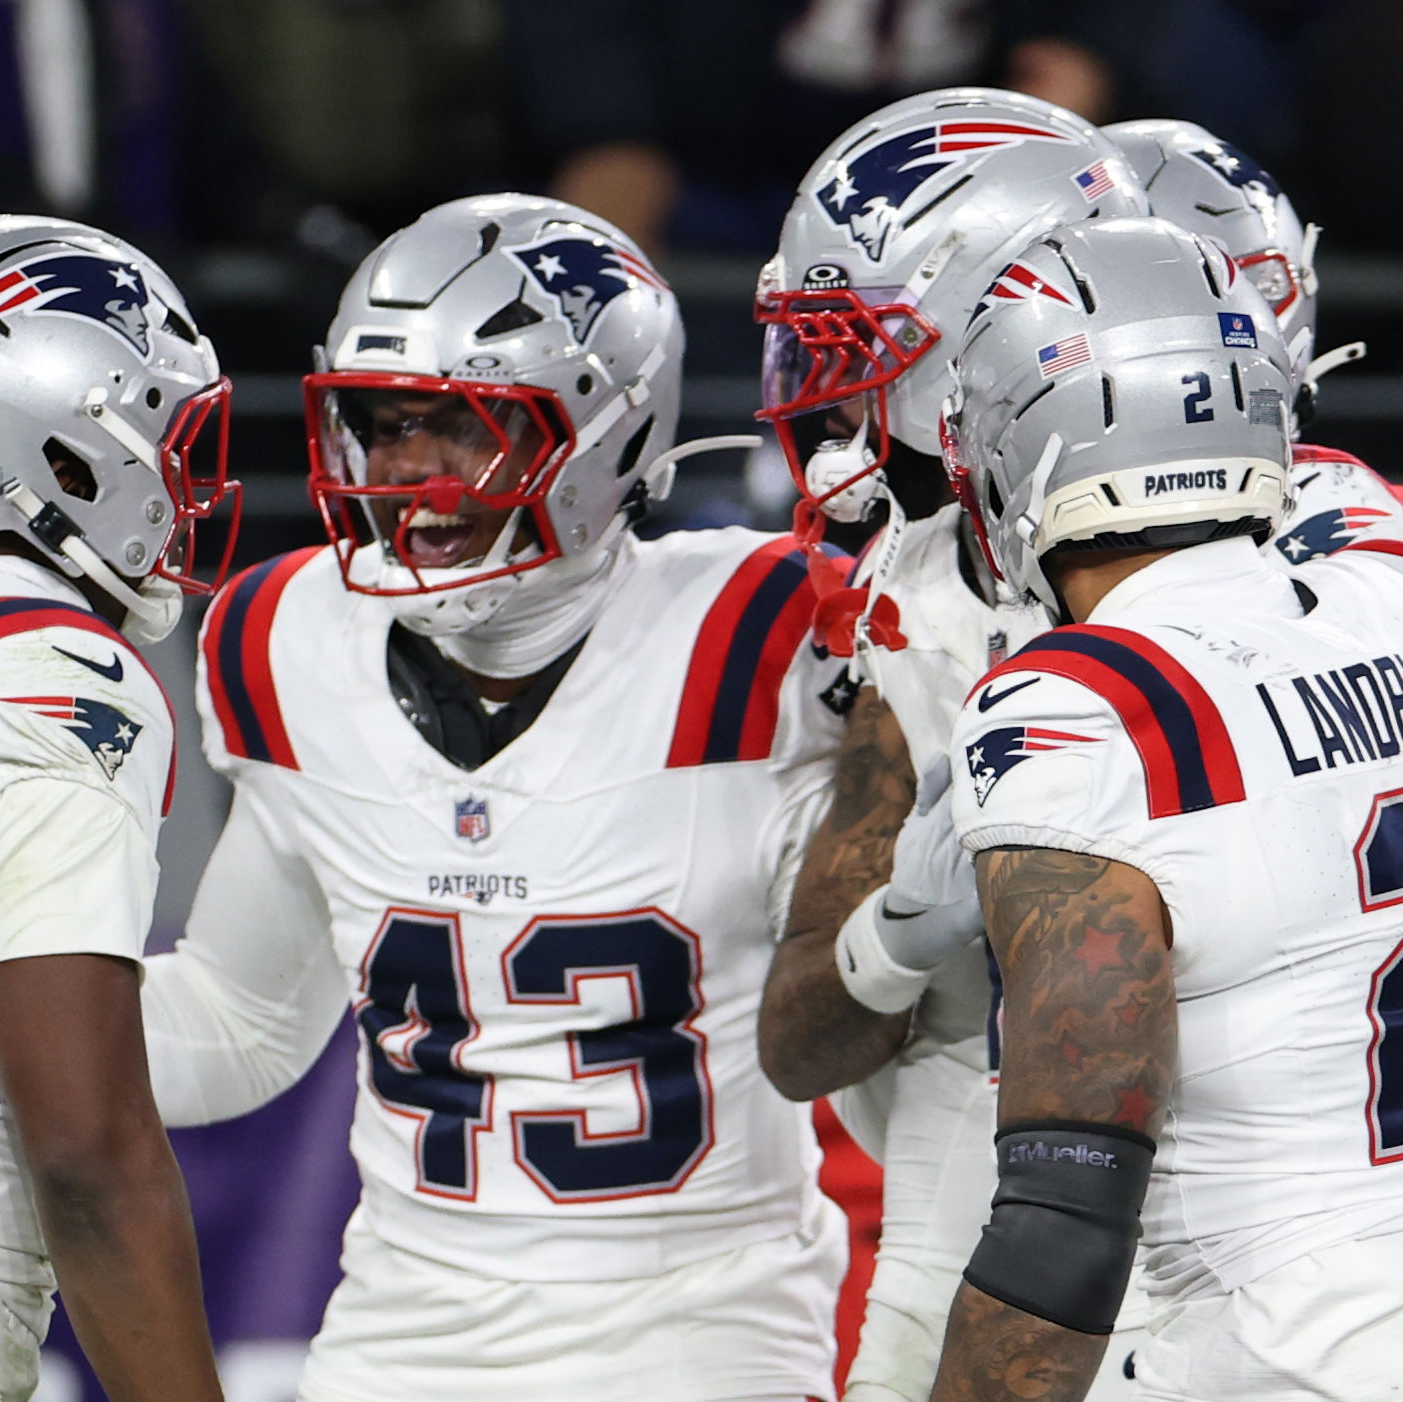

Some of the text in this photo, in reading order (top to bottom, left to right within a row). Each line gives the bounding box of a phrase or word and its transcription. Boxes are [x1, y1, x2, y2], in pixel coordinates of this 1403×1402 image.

[1181, 371, 1215, 424] 2
[1144, 468, 1228, 498] PATRIOTS
[428, 873, 528, 899] PATRIOTS
[355, 906, 715, 1202] 43
